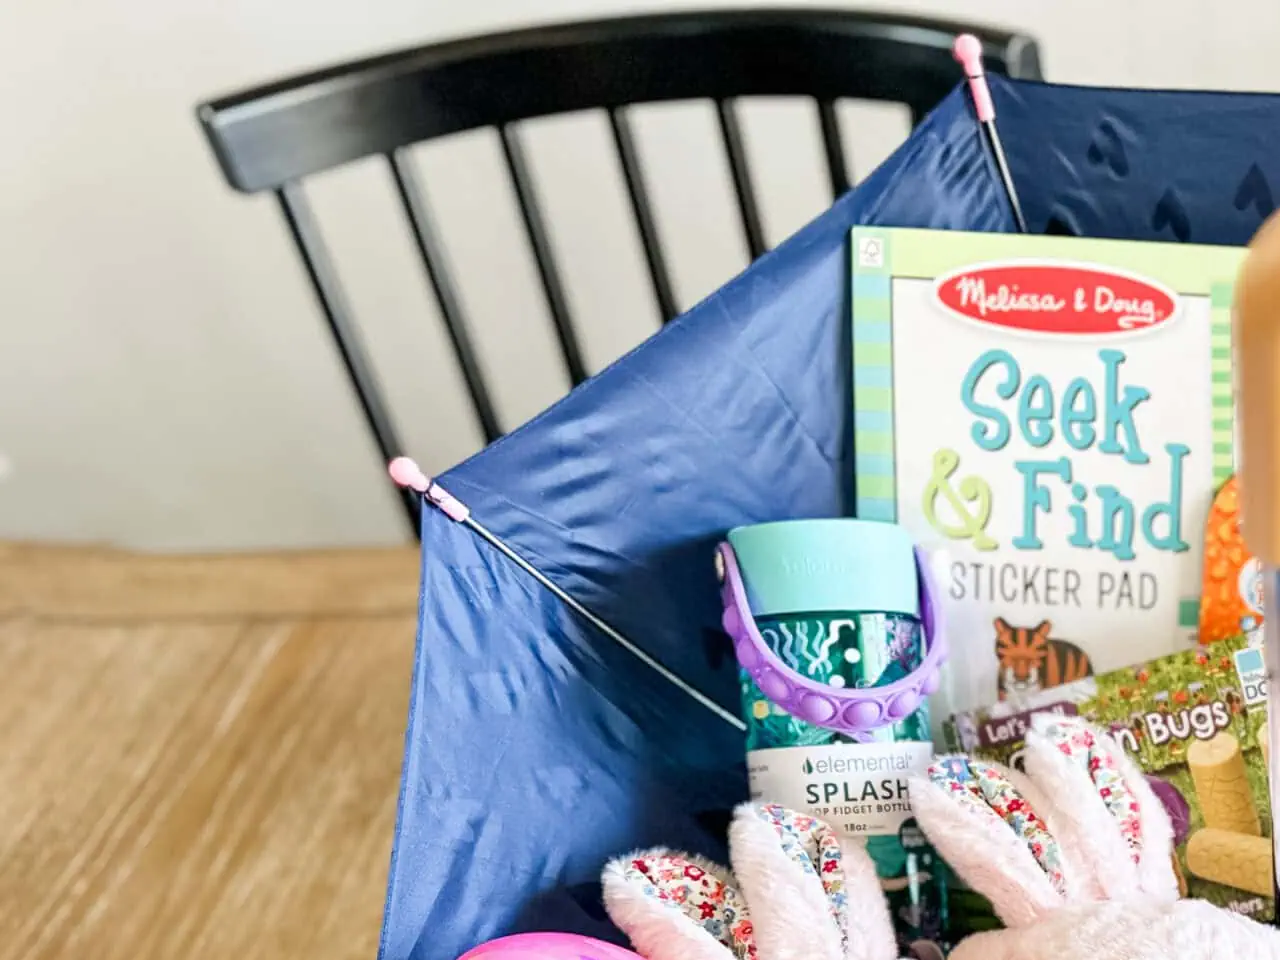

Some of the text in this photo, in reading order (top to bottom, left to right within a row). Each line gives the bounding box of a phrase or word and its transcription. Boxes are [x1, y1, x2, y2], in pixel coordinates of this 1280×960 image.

[955, 276, 1066, 316] Melissa
[1094, 285, 1157, 329] Doug
[960, 348, 1151, 464] Seek
[922, 443, 1190, 560] & Find
[949, 561, 1159, 610] STICKER PAD
[1145, 701, 1229, 744] Bugs
[815, 753, 910, 775] elemental
[806, 778, 910, 805] SPLASH
[810, 806, 829, 816] OP
[833, 804, 873, 816] FIDGET
